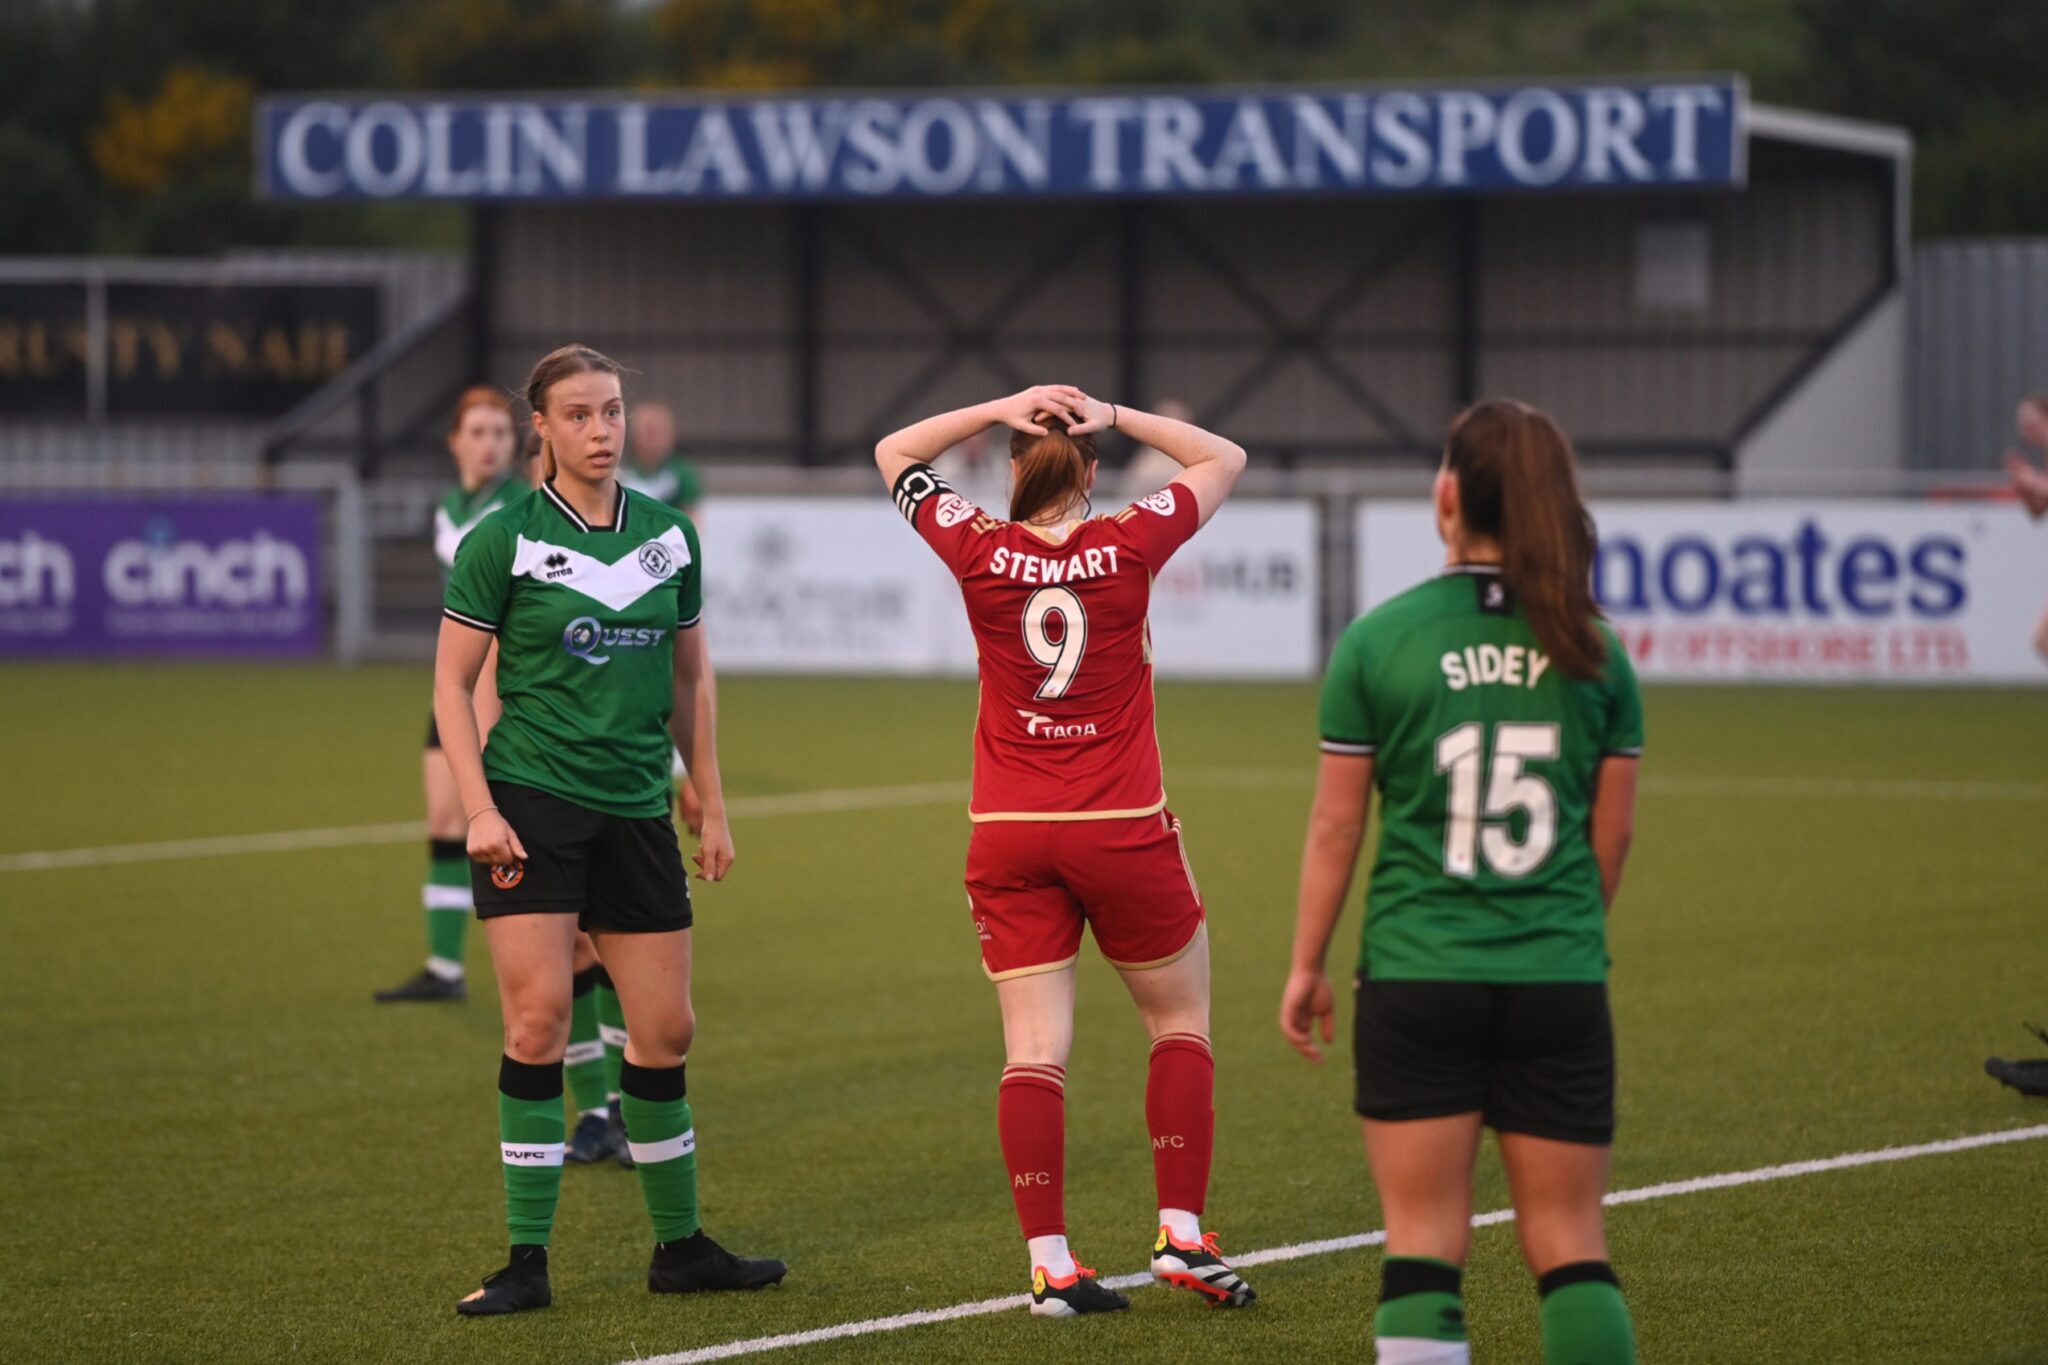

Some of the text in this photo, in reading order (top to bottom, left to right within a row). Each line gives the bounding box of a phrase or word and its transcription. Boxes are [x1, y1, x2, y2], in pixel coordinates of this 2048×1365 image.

[279, 87, 1723, 197] COLIN LAWSON TRANSPORT
[104, 517, 308, 604] cinch
[990, 545, 1118, 583] STEWART
[1021, 584, 1087, 700] 9
[1441, 644, 1549, 690] SIDEY
[1433, 721, 1561, 880] 15
[505, 1150, 545, 1160] DUFC
[1153, 1135, 1185, 1151] AFC
[1014, 1171, 1050, 1188] AFC
